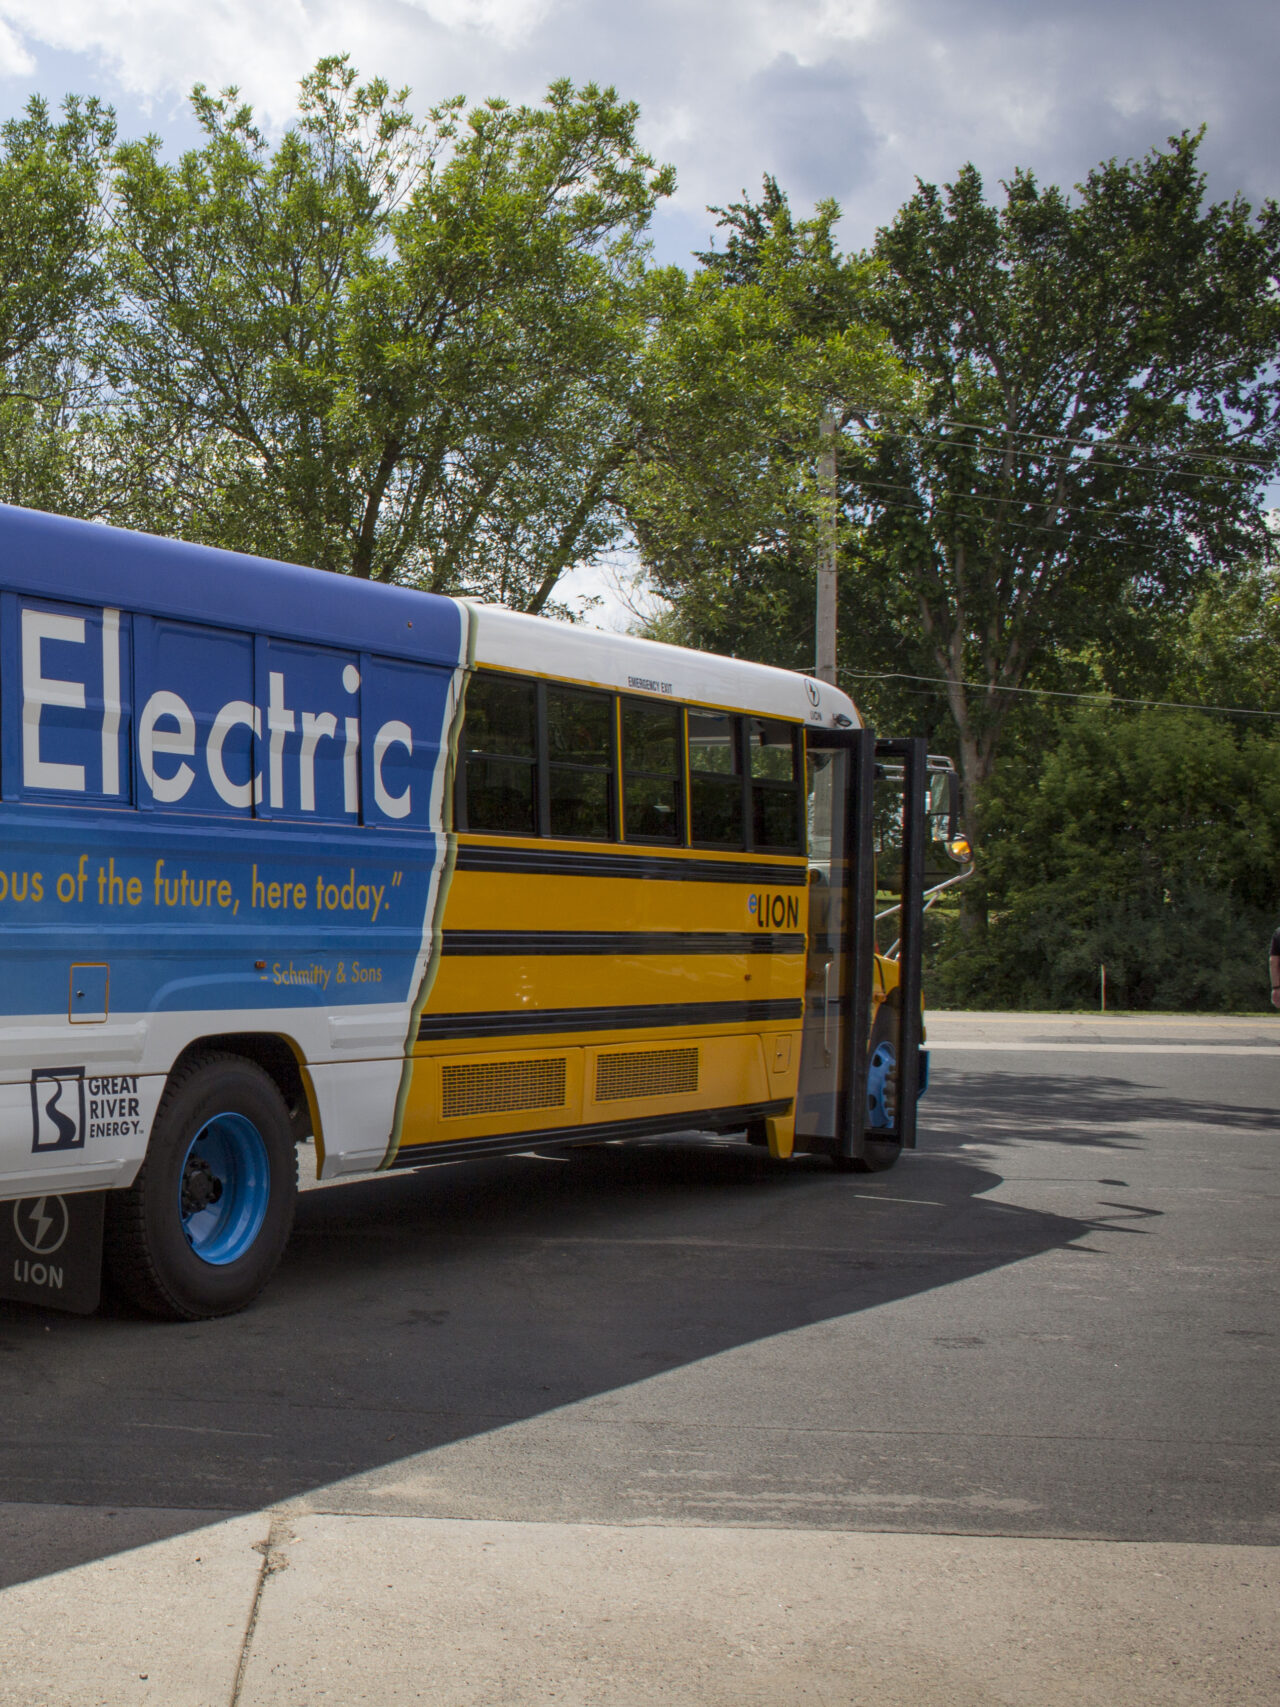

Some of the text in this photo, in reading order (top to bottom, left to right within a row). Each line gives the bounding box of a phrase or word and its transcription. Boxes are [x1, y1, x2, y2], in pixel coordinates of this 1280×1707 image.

[628, 676, 672, 695] EMERGENCY EXIT
[22, 607, 412, 819] Electric
[56, 854, 89, 903] of
[98, 857, 142, 905] the
[154, 859, 240, 915] future,
[251, 864, 307, 909] here
[272, 960, 331, 991] Schmitty
[336, 961, 347, 983] &
[351, 961, 383, 983] Sons
[88, 1076, 139, 1096] GREAT
[90, 1098, 140, 1119] RIVER
[14, 1259, 63, 1289] LION
